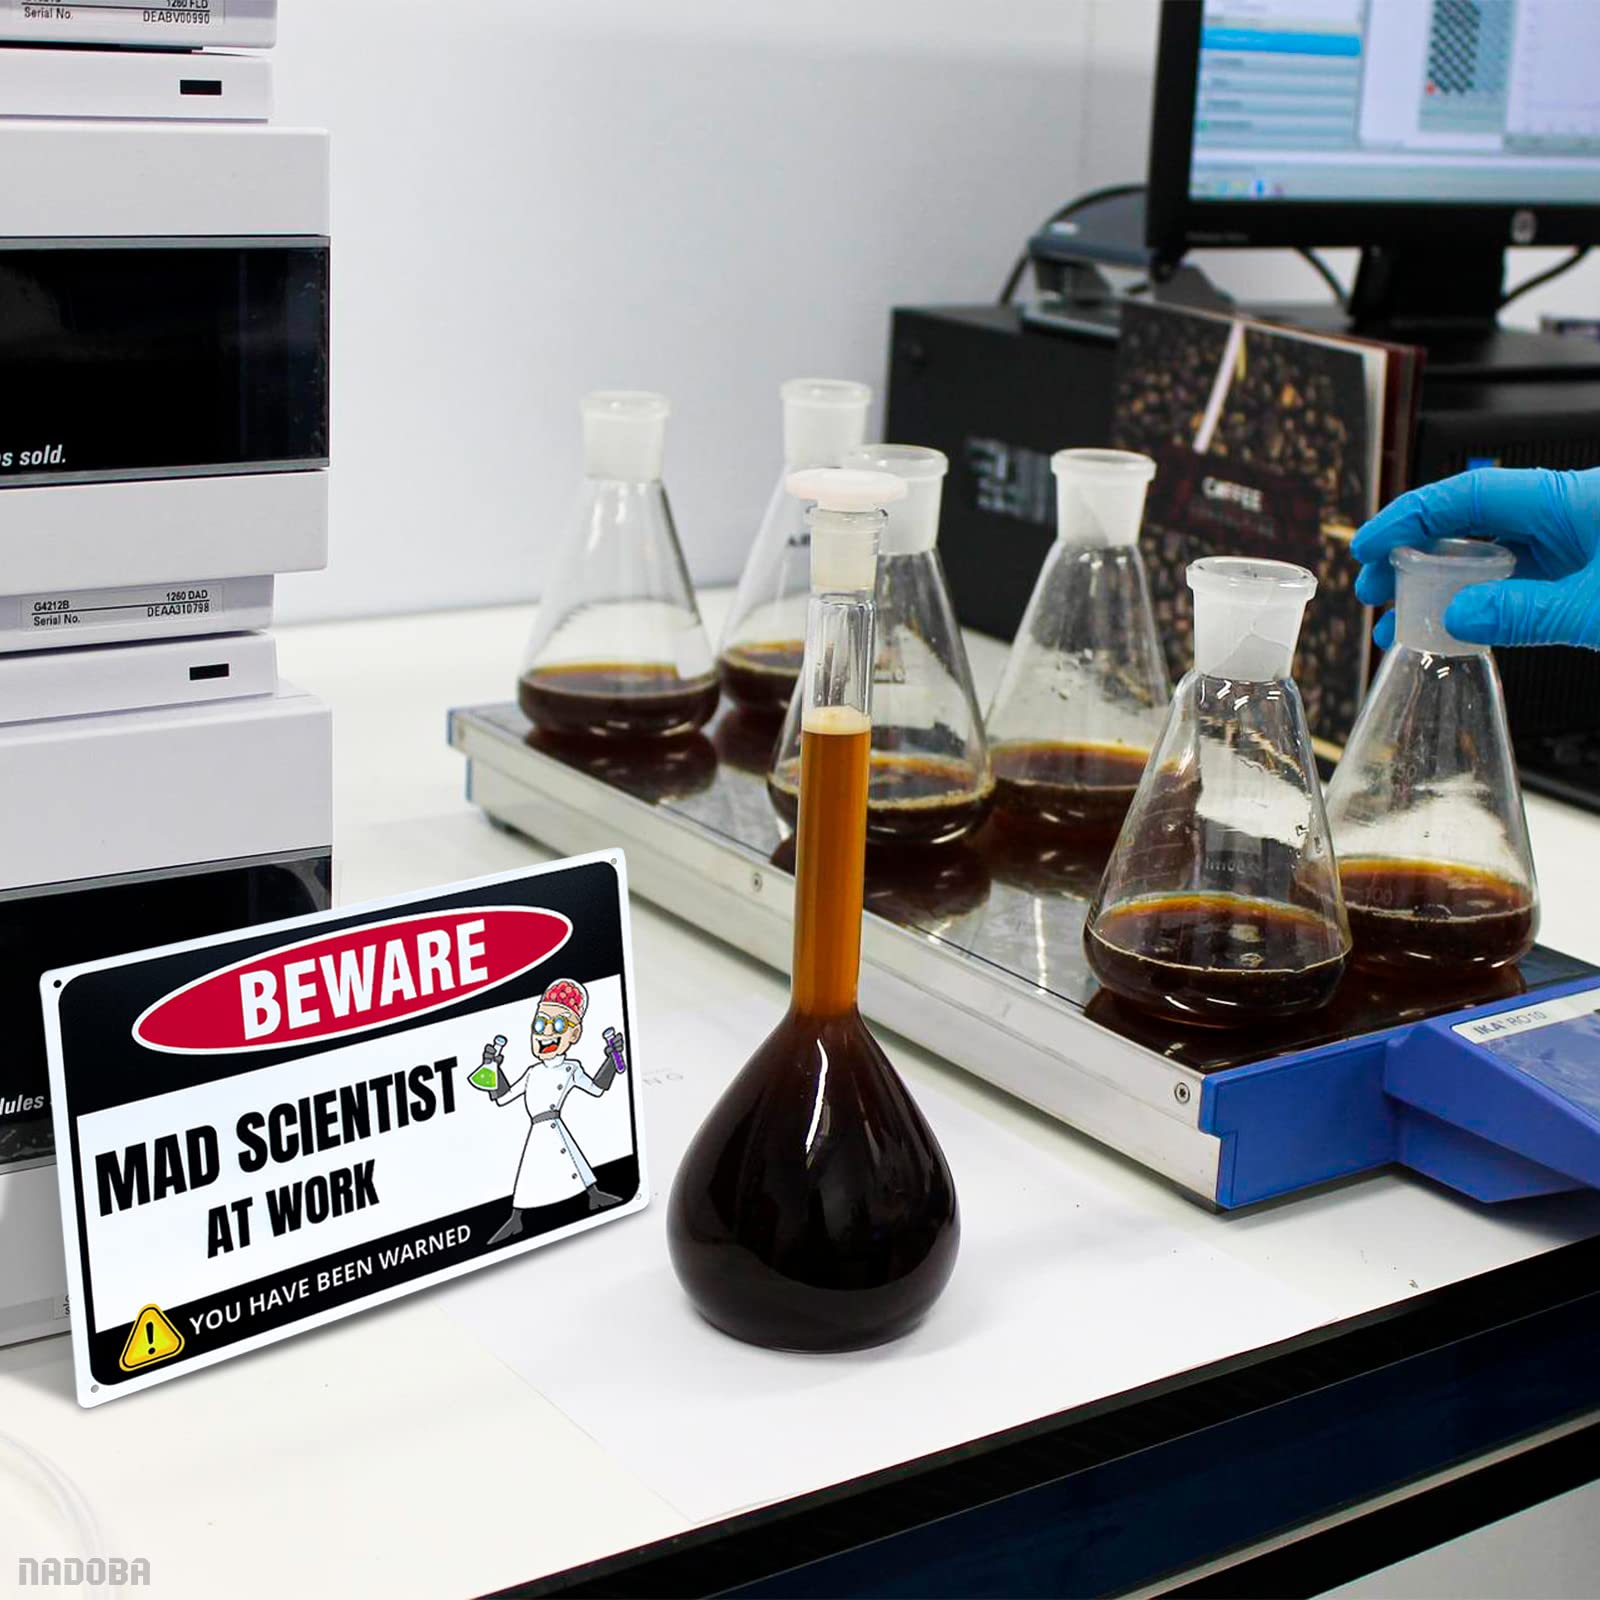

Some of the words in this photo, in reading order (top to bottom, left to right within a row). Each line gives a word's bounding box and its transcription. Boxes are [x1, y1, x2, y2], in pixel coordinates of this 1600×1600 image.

[24, 6, 53, 19] Serial
[55, 8, 74, 20] No.
[19, 443, 66, 466] sold.
[33, 599, 70, 613] G4212B
[166, 591, 187, 601] 1260
[188, 589, 208, 600] DAD
[33, 613, 61, 627] Serial
[63, 612, 81, 625] No.
[238, 919, 490, 1041] BEWARE
[94, 1124, 221, 1217] MAD
[236, 1056, 459, 1174] SCIENTIST
[206, 1196, 254, 1259] AT
[266, 1158, 380, 1238] WORK
[188, 1301, 242, 1335] YOU
[249, 1277, 310, 1316] HAVE
[316, 1256, 373, 1293] BEEN
[378, 1223, 472, 1270] WARNED
